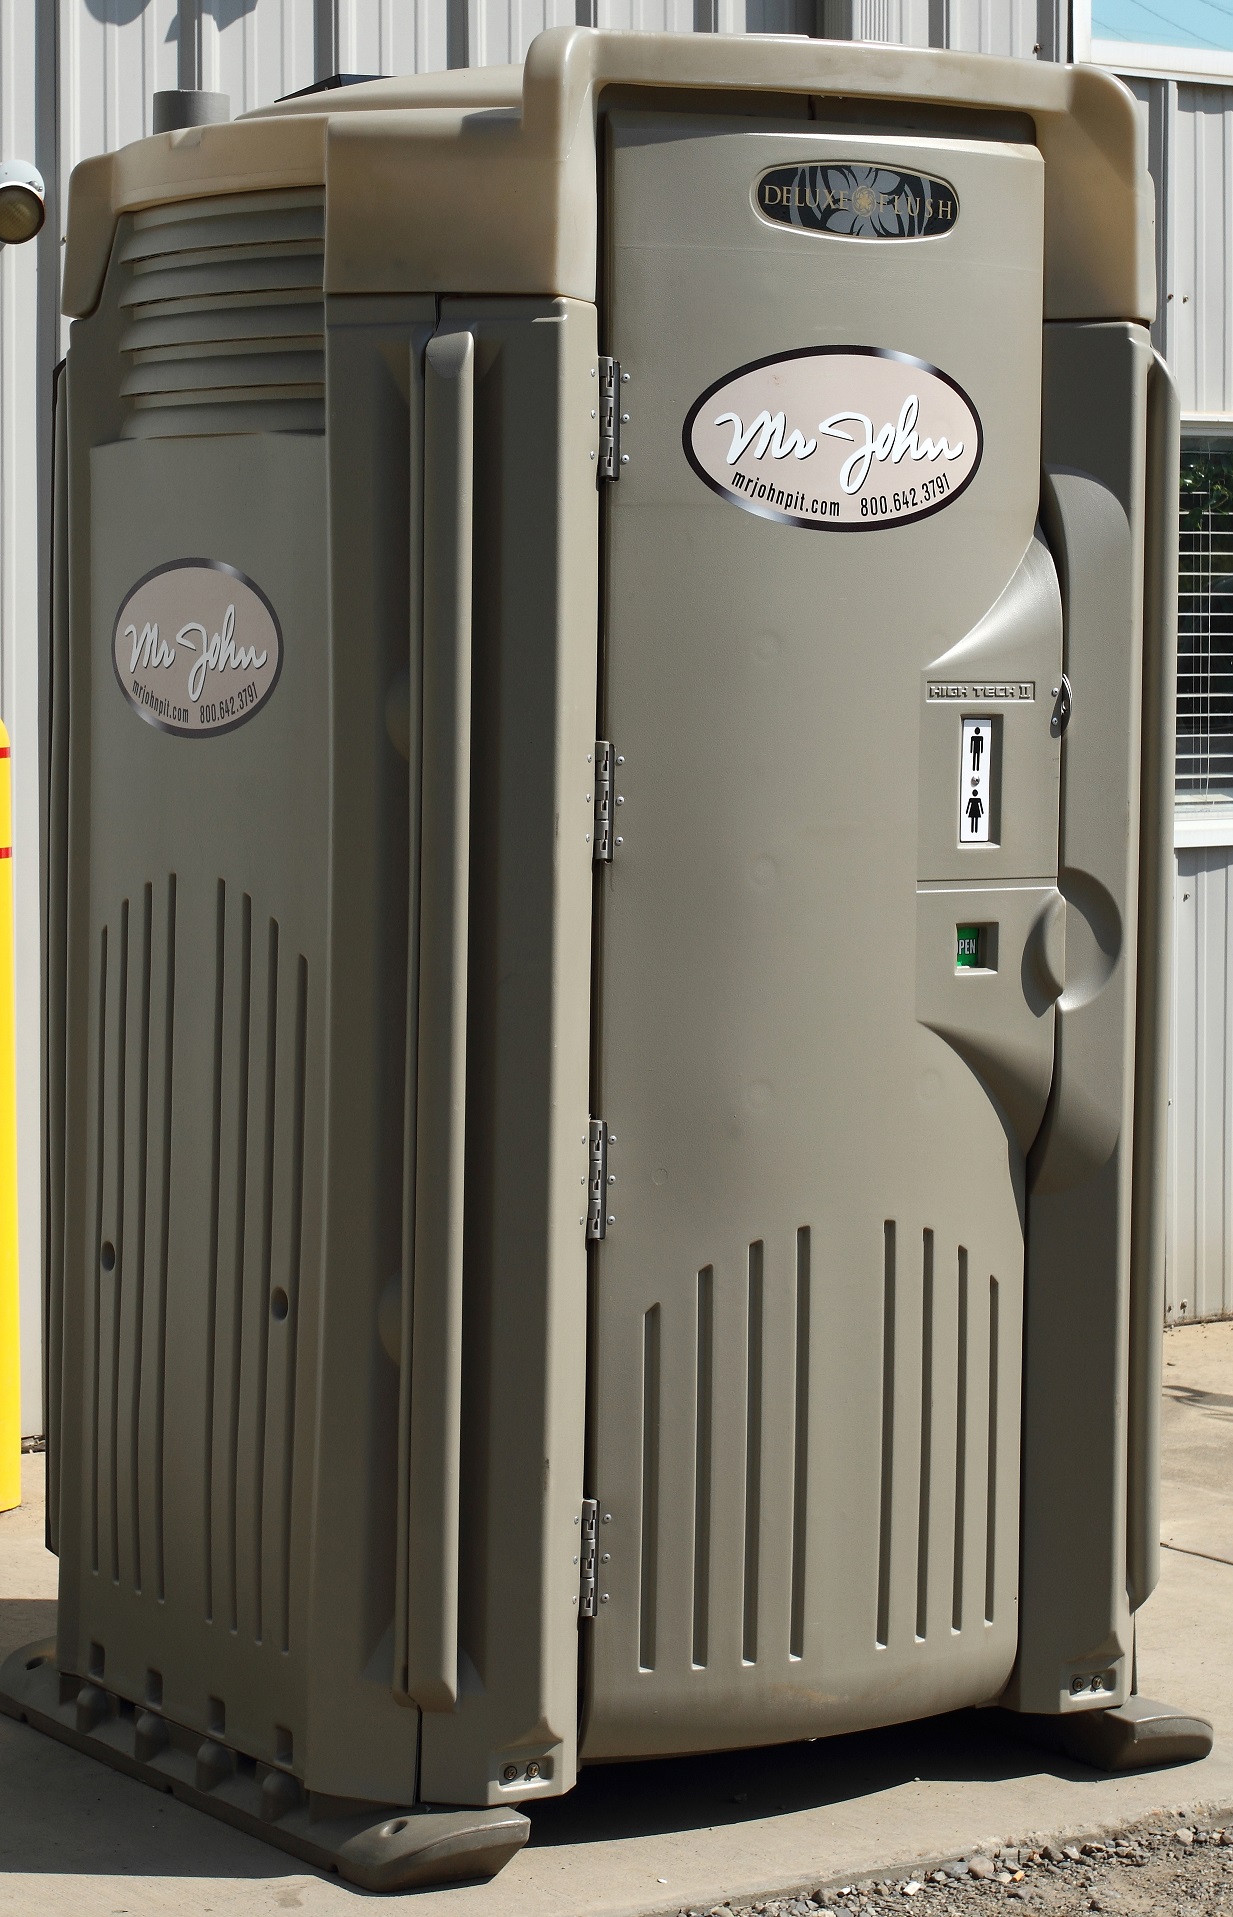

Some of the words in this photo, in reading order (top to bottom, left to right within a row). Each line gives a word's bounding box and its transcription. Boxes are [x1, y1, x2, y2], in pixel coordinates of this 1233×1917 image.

[764, 184, 850, 210] DELUXE
[879, 194, 952, 220] FLUSH
[714, 410, 818, 466] Mr
[818, 394, 964, 495] John
[731, 471, 840, 517] mrjohnpit.com
[860, 472, 951, 517] 800.642.3791
[125, 622, 176, 673] Mr
[176, 604, 268, 702] John
[132, 679, 189, 723] mrjohnpit.com
[200, 681, 258, 724] 800.642.3791
[929, 686, 968, 698] HIGH
[972, 686, 1015, 698] TECH
[957, 939, 976, 955] PEN
